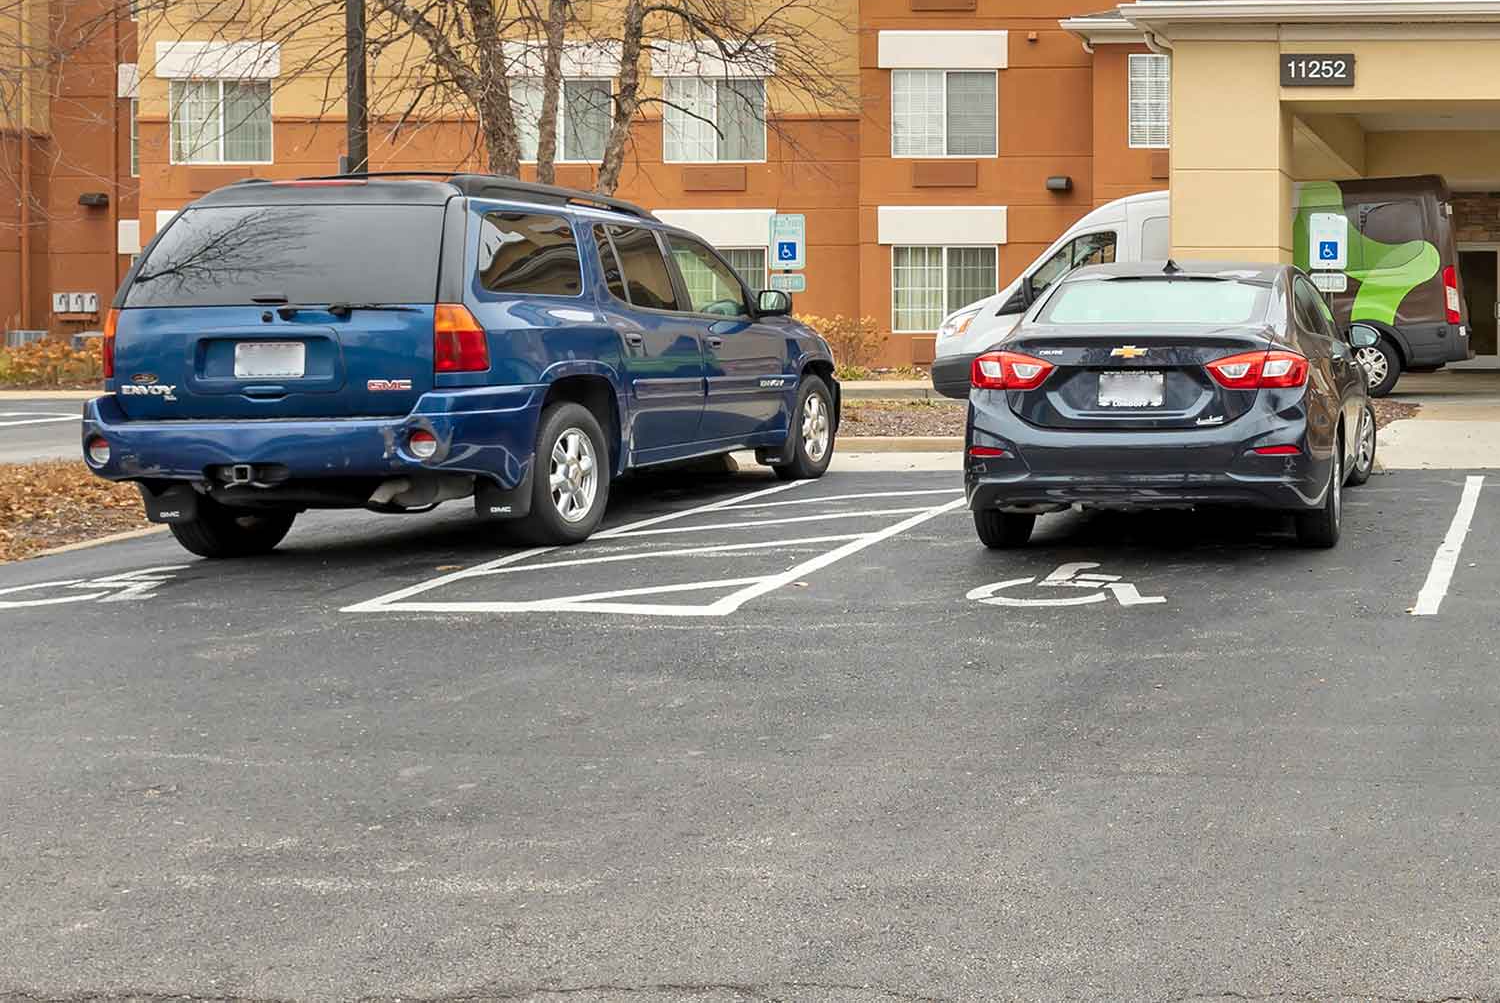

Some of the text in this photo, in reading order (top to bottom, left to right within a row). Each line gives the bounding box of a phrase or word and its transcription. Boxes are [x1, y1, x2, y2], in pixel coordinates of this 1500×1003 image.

[1288, 60, 1346, 78] 11252
[367, 379, 412, 390] GMC
[121, 385, 177, 395] ENVOY
[159, 510, 180, 518] GMC
